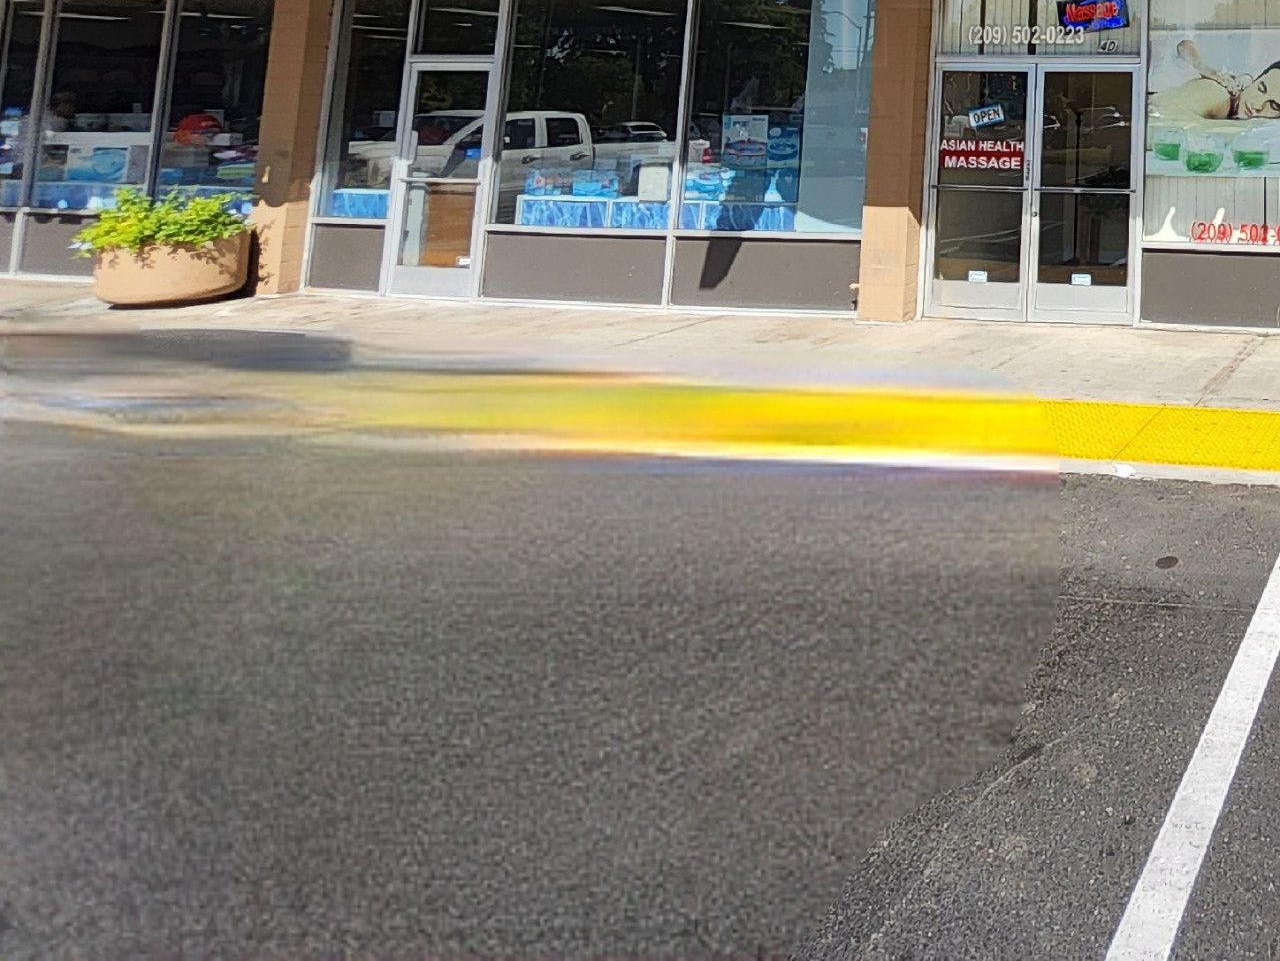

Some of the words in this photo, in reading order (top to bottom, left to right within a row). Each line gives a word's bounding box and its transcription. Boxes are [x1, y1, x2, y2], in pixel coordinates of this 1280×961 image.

[968, 25, 1007, 45] (209)
[1012, 25, 1085, 45] 502-0223
[973, 108, 1001, 124] OPEN
[940, 139, 975, 151] ASIAN
[979, 140, 1024, 152] HEALTH
[944, 156, 1021, 169] MASSAGE
[1191, 222, 1232, 243] (209)
